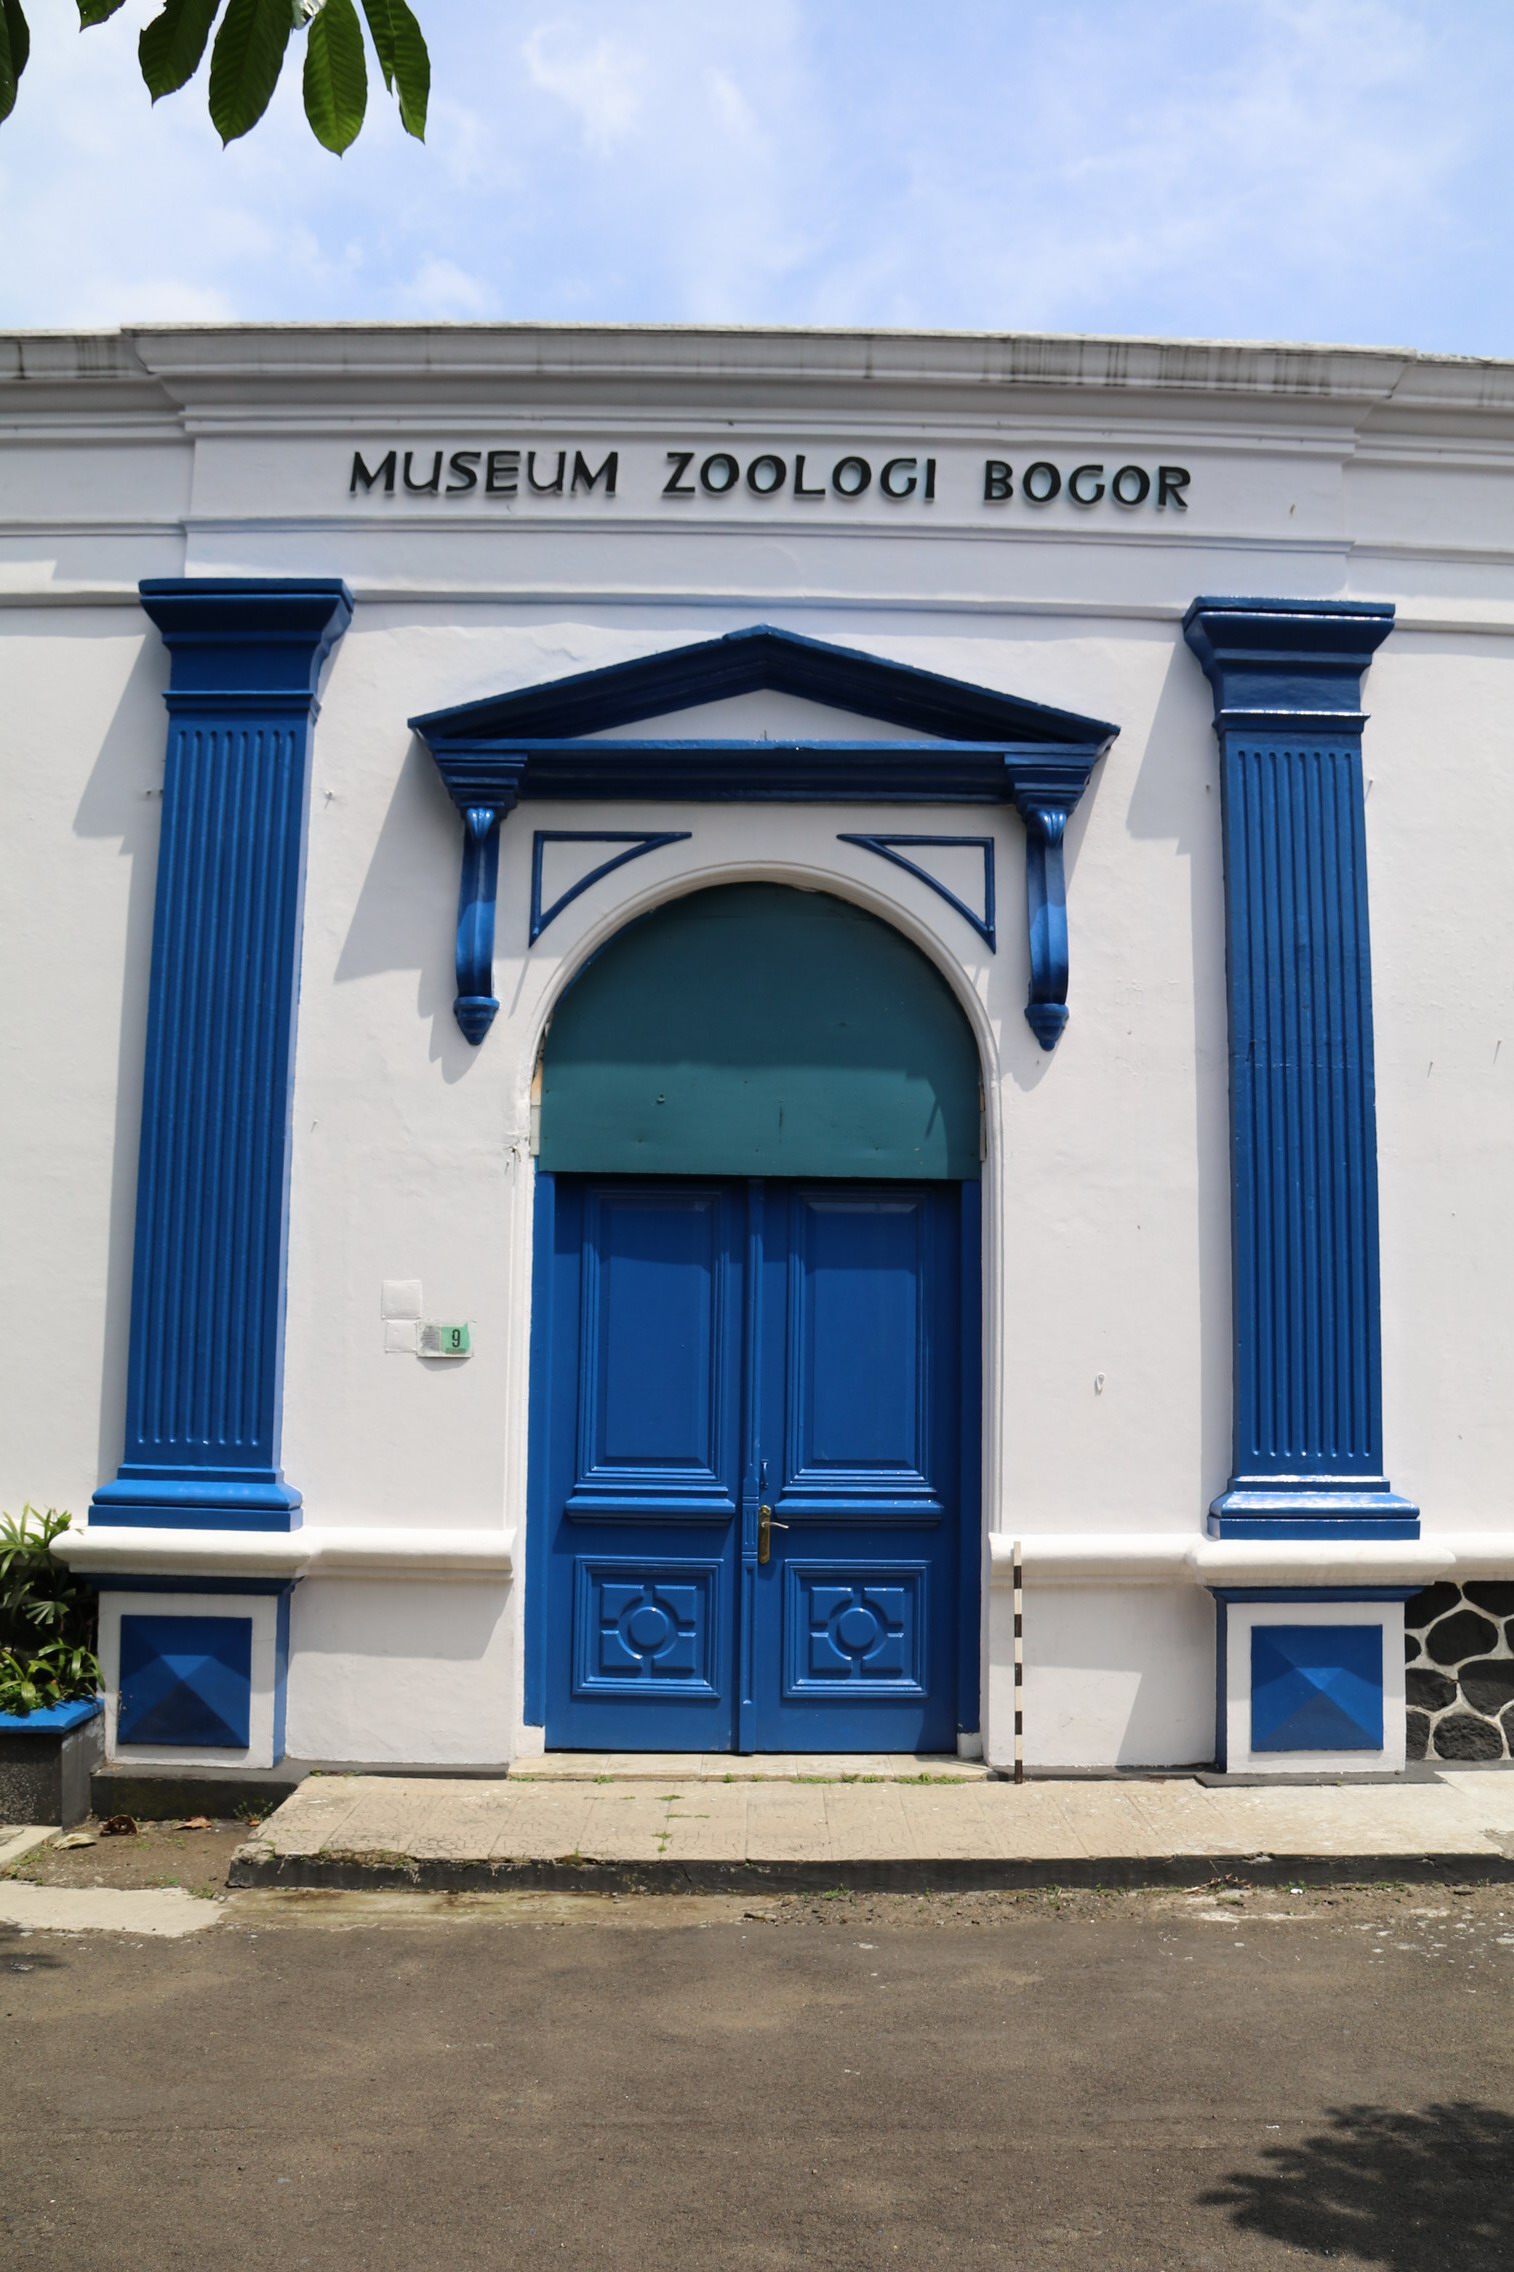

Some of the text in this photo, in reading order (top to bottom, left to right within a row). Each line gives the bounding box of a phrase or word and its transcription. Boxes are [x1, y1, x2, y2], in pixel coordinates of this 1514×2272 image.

[349, 450, 1191, 508] MUSEUM ZOOLOGI BOGOR
[451, 1328, 461, 1348] 9
